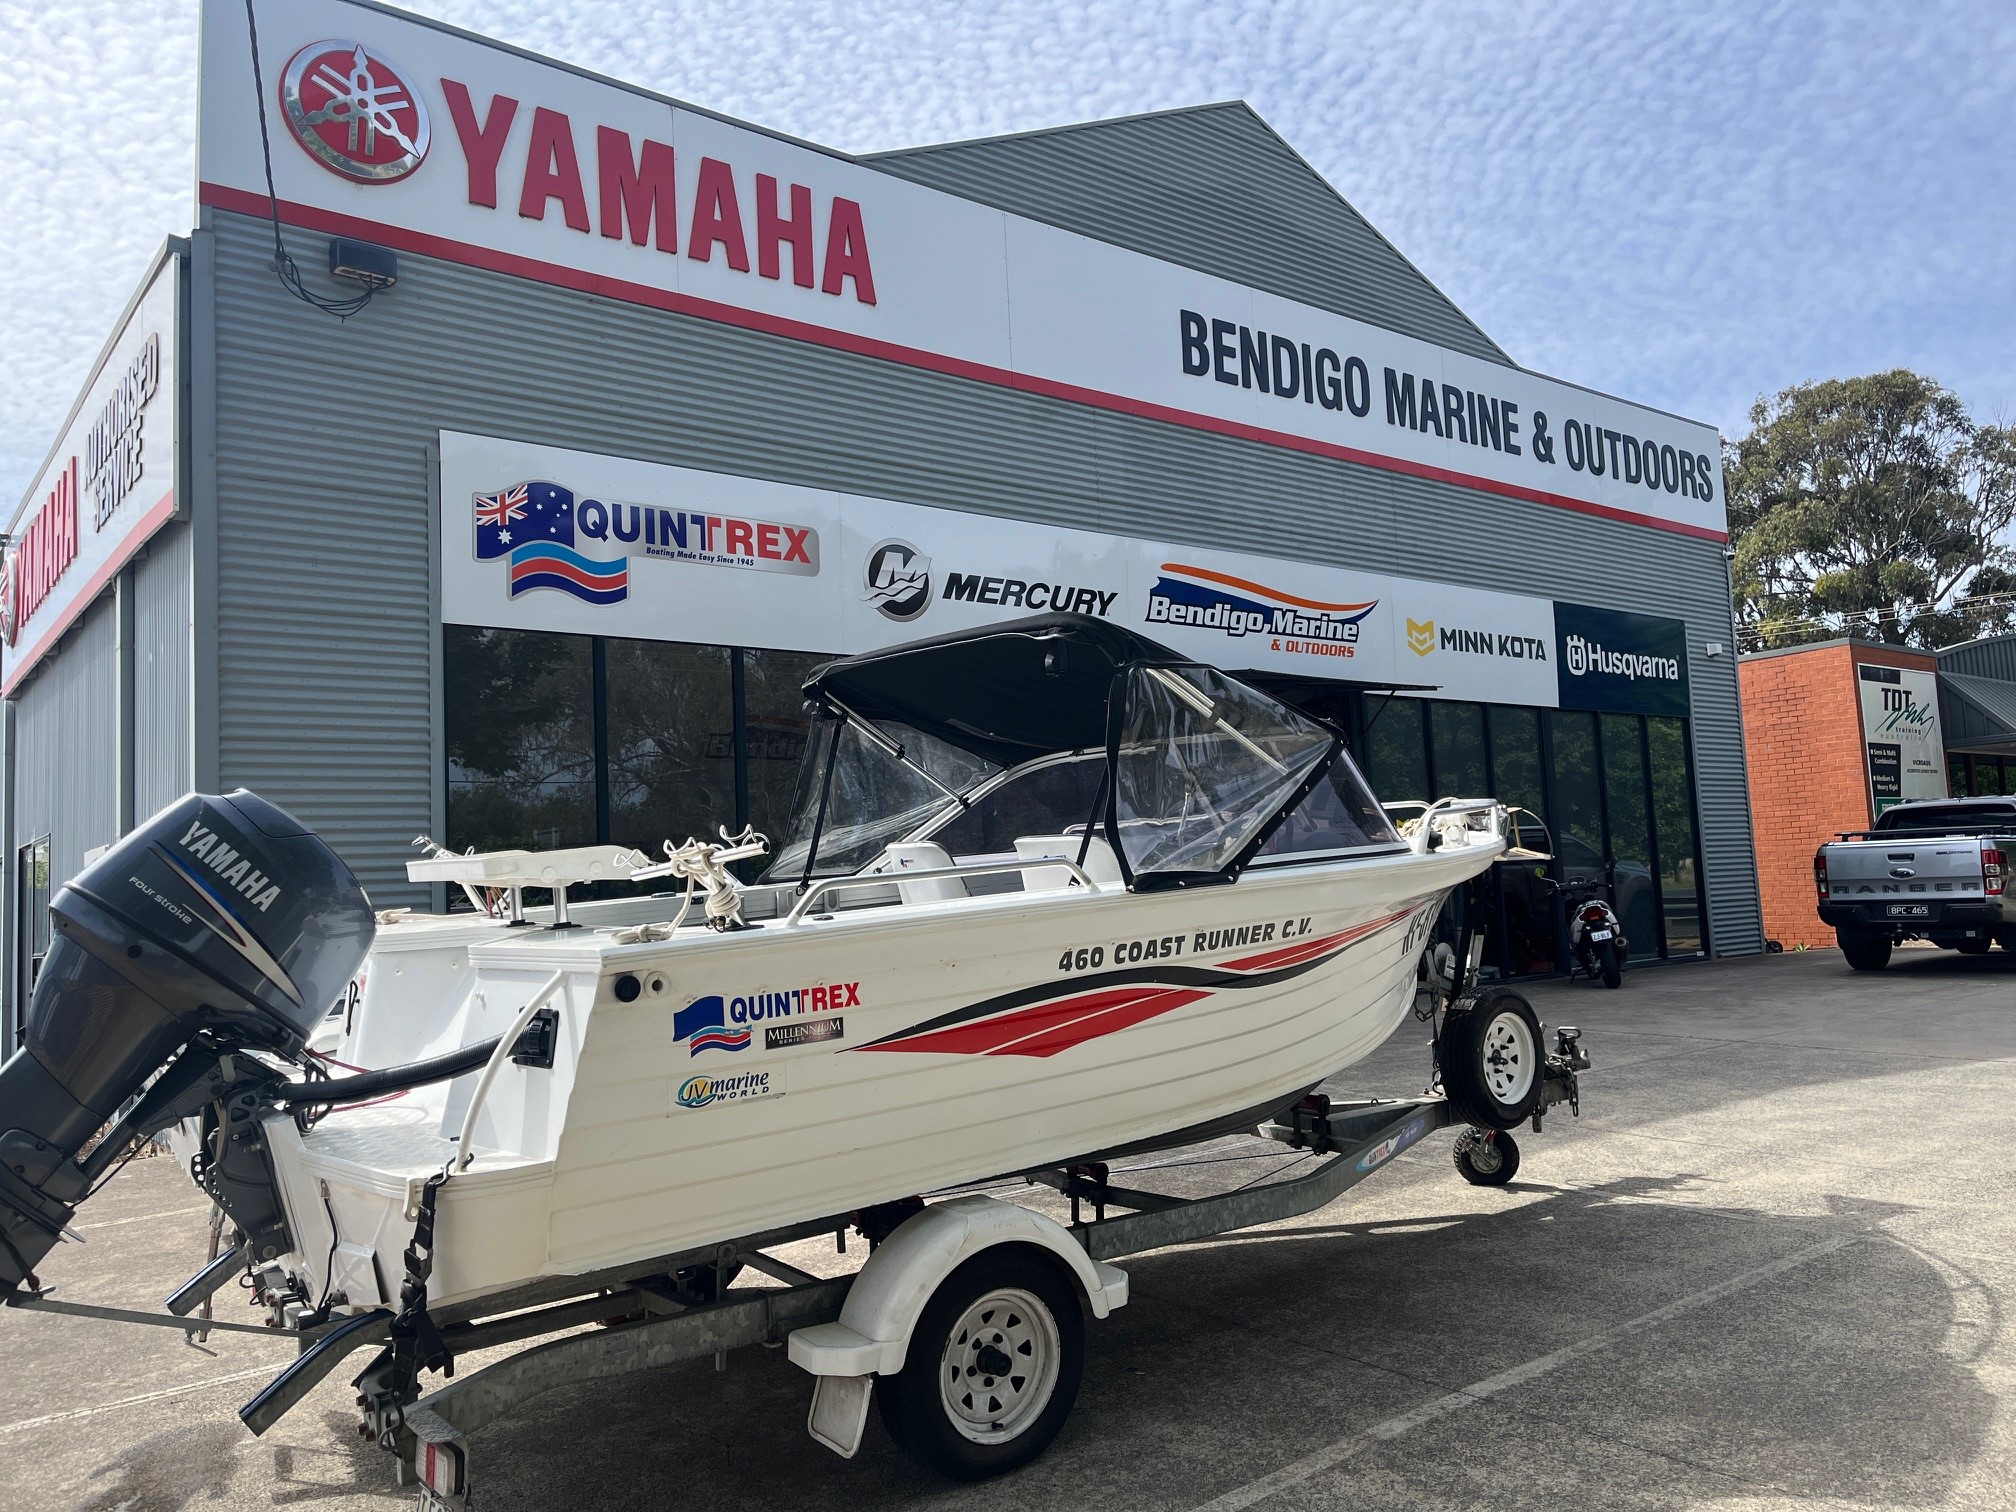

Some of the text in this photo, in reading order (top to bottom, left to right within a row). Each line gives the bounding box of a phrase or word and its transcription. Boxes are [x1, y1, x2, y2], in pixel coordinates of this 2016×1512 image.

[440, 77, 877, 306] YAMAHA
[84, 332, 162, 492] AUTHORISED
[1180, 309, 1714, 503] BENDIGO MARINE & OUTDOORS
[93, 414, 146, 534] SERVICE
[18, 455, 80, 628] YAMAHA
[577, 498, 812, 564] QUINTREX
[646, 547, 754, 566] Boating Made Easy Since 1945
[942, 572, 1119, 617] MERCURY
[1149, 595, 1359, 641] Bendigo Marine
[1271, 639, 1355, 658] & OUTDOORS
[1440, 627, 1547, 662] MINN KOTA
[1587, 642, 1679, 681] Husqvarna
[1881, 687, 1912, 712] TDT
[1895, 726, 1921, 735] training
[178, 820, 283, 913] YAMAHA
[1832, 882, 1981, 894] RANGER
[1058, 917, 1313, 972] 460 COAST RUNNER C.V.
[729, 981, 861, 1024] QUINTREX
[767, 1018, 841, 1042] MILLENNIUM
[778, 1036, 806, 1045] SERIES
[681, 1071, 770, 1102] JV marine
[717, 1086, 770, 1102] WORLD
